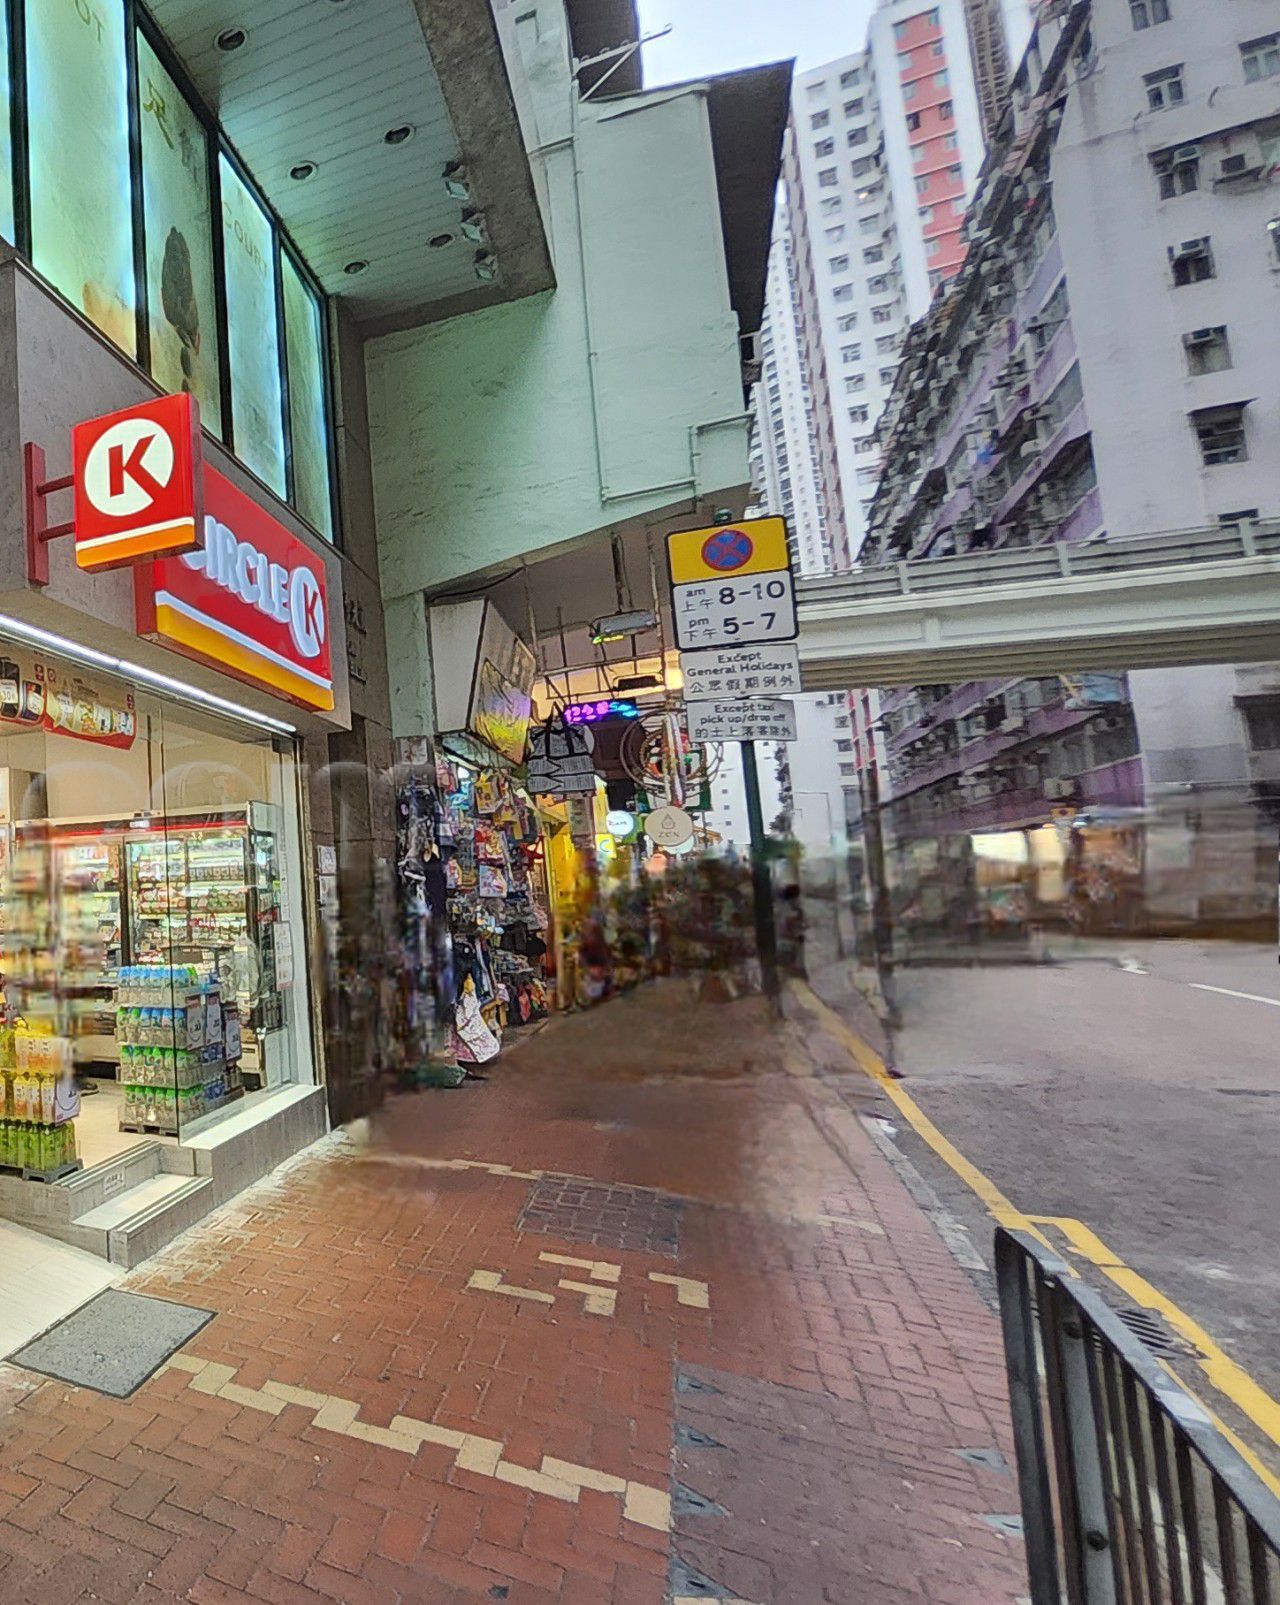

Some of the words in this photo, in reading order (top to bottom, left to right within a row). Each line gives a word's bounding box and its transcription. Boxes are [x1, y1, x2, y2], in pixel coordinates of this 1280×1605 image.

[686, 587, 706, 597] am
[719, 580, 786, 605] 8-10
[682, 599, 714, 613] 上午
[688, 618, 710, 629] pm
[683, 629, 718, 642] 下午
[718, 652, 762, 664] Except
[687, 665, 736, 677] General
[740, 661, 793, 674] Holidays
[714, 703, 755, 714] Except
[700, 713, 723, 725] pick
